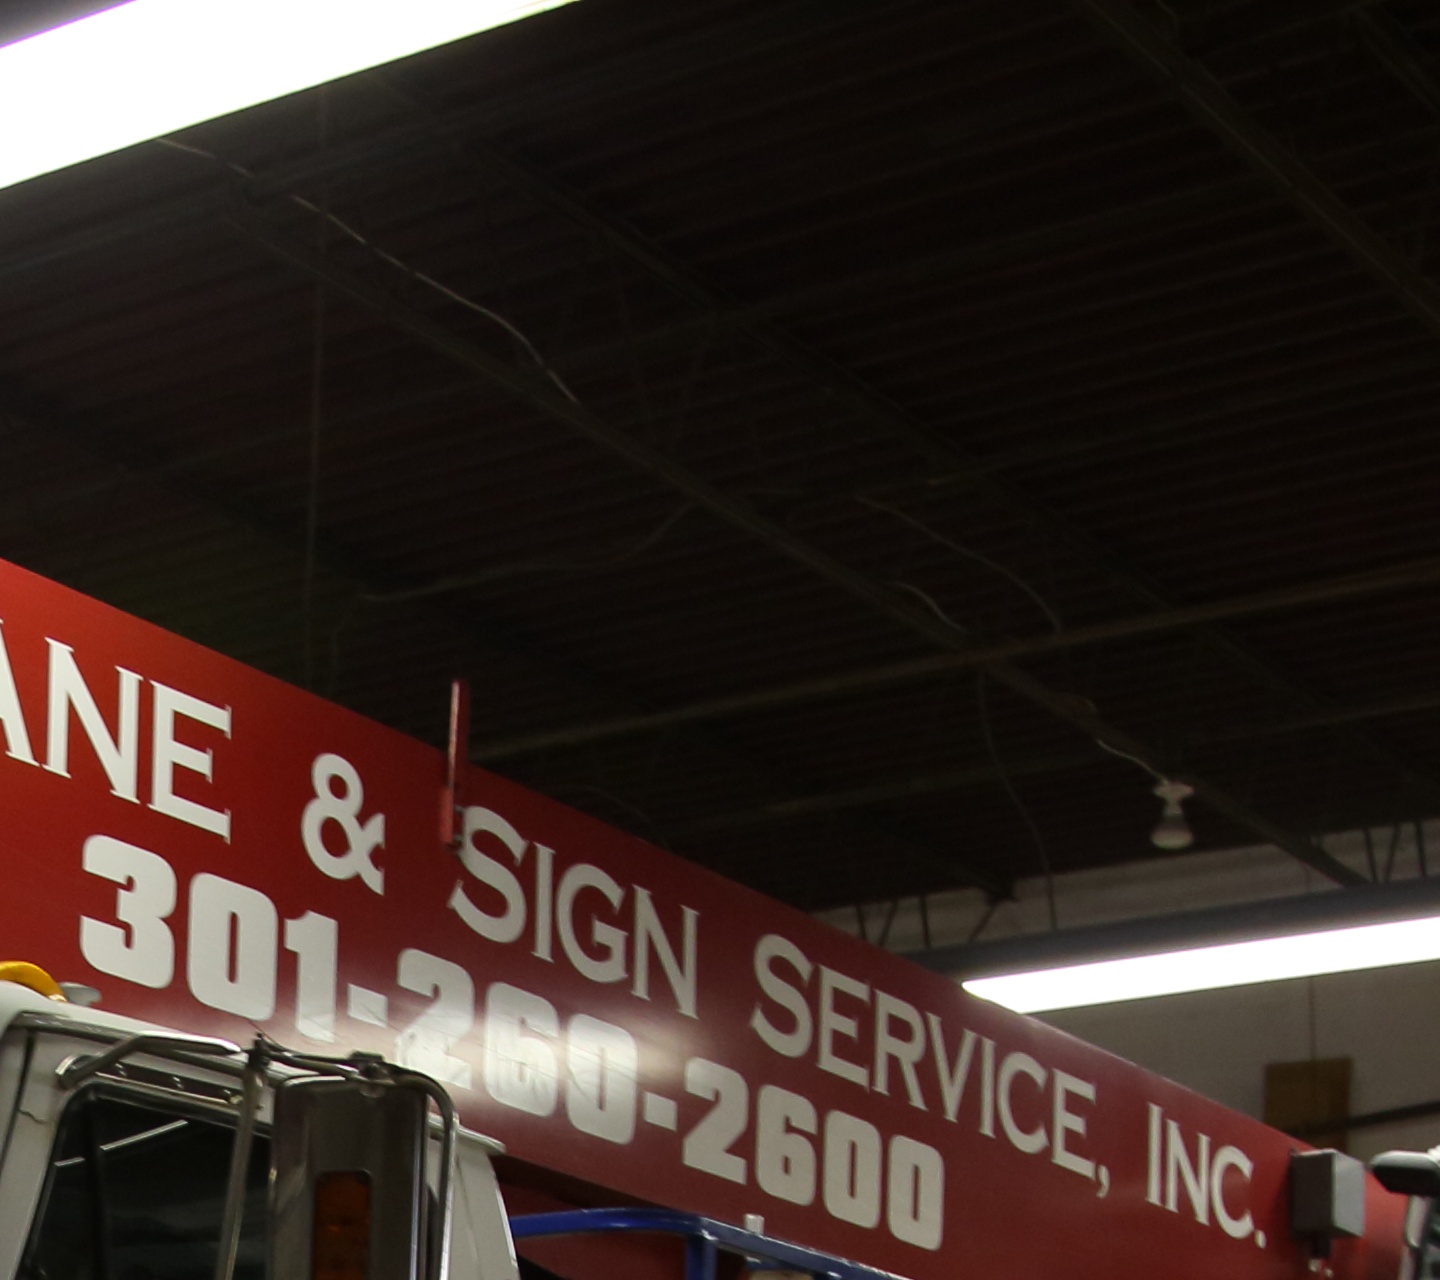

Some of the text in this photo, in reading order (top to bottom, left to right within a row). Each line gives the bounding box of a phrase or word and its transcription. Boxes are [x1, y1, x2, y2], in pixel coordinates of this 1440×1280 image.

[80, 835, 945, 1252] 301-260-2600
[301, 754, 384, 895] &
[448, 807, 700, 1018] SIGN
[751, 935, 1110, 1198] SERVICE,
[1146, 1103, 1267, 1248] INC.
